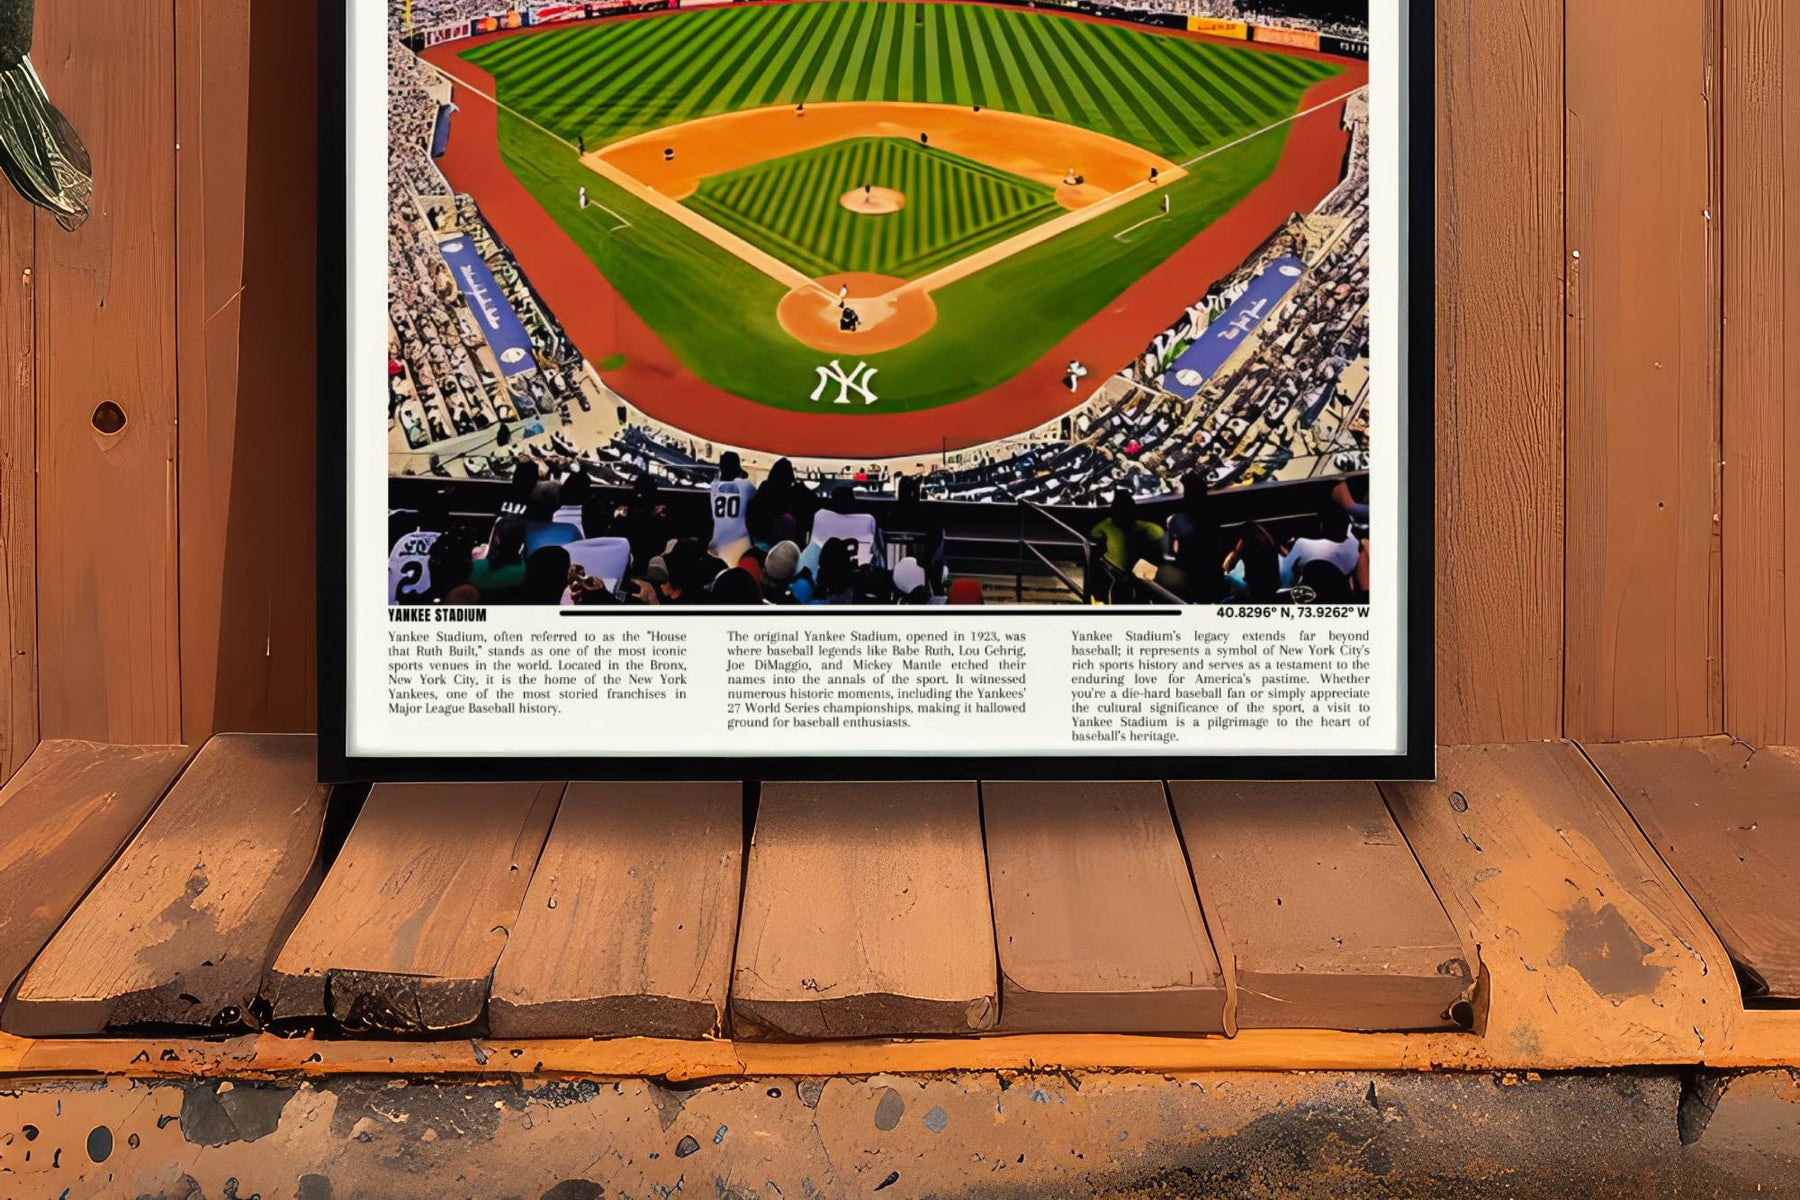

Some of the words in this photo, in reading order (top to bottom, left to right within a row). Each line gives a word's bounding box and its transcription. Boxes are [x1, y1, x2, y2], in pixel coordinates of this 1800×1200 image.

[810, 359, 878, 405] NY
[388, 608, 431, 622] YANKEE
[435, 608, 487, 622] STADIUM
[1281, 607, 1295, 621] N,
[1357, 607, 1370, 618] W
[389, 631, 429, 643] Yankee
[437, 631, 487, 644] Stadium,
[494, 631, 523, 643] often
[531, 631, 577, 643] referred
[585, 631, 595, 643] to
[602, 634, 615, 643] as
[622, 631, 640, 643] the
[727, 630, 749, 642] The
[754, 630, 798, 645] original
[804, 630, 845, 642] Yankee
[850, 630, 901, 644] Stadium,
[906, 630, 948, 645] opened
[954, 630, 965, 642] in
[971, 630, 1000, 644] 1923,
[1005, 633, 1026, 642] was
[1072, 630, 1113, 642] Yankee
[1195, 630, 1229, 645] legacy
[1242, 630, 1286, 642] extends
[1300, 630, 1316, 642] far
[1329, 630, 1369, 645] beyond
[388, 645, 410, 657] that
[416, 645, 443, 657] Ruth
[488, 645, 525, 657] stands
[530, 648, 544, 657] as
[549, 648, 571, 657] one
[576, 645, 589, 657] of
[594, 645, 612, 657] the
[618, 645, 646, 657] most
[652, 645, 687, 657] iconic
[727, 645, 762, 657] where
[767, 645, 813, 657] baseball
[819, 645, 862, 660] legends
[867, 645, 887, 657] like
[893, 645, 919, 657] Babe
[925, 645, 954, 658] Ruth,
[959, 645, 979, 657] Lou
[985, 645, 1026, 660] Gehrig,
[1072, 644, 1121, 659] baseball;
[1127, 644, 1134, 656] it
[1140, 644, 1200, 659] represents
[1205, 647, 1211, 656] a
[1217, 644, 1257, 659] symbol
[1263, 644, 1275, 656] of
[1280, 644, 1303, 656] New
[1309, 644, 1335, 656] York
[388, 659, 423, 674] sports
[429, 662, 469, 671] venues
[475, 659, 486, 671] in
[493, 659, 511, 671] the
[517, 659, 552, 671] world.
[559, 659, 601, 671] Located
[609, 659, 619, 671] in
[626, 659, 644, 671] the
[651, 659, 686, 673] Bronx,
[726, 659, 745, 674] Joe
[755, 659, 811, 674] DiMaggio,
[821, 659, 842, 671] and
[853, 659, 892, 674] Mickey
[903, 659, 941, 671] Mantle
[951, 659, 988, 671] etched
[999, 659, 1026, 671] their
[1072, 658, 1094, 670] rich
[1099, 658, 1134, 673] sports
[1139, 658, 1178, 673] history
[1182, 658, 1204, 670] and
[1208, 661, 1243, 670] serves
[1248, 661, 1260, 670] as
[1265, 661, 1272, 670] a
[1276, 658, 1332, 670] testament
[1337, 658, 1348, 670] to
[1352, 658, 1370, 670] the
[728, 676, 765, 685] names
[773, 673, 795, 685] into
[802, 673, 820, 685] the
[828, 673, 866, 685] annals
[873, 673, 885, 685] of
[892, 673, 909, 685] the
[916, 673, 949, 688] sport.
[956, 673, 963, 685] It
[970, 673, 1026, 685] witnessed
[1071, 673, 1125, 688] enduring
[1135, 673, 1157, 685] love
[1168, 673, 1185, 685] for
[1262, 673, 1309, 688] pastime.
[1320, 673, 1370, 685] Whether
[388, 688, 438, 702] Yankees,
[446, 691, 467, 700] one
[476, 688, 488, 700] of
[496, 688, 514, 700] the
[523, 688, 551, 700] most
[559, 688, 598, 700] storied
[607, 688, 666, 700] franchises
[675, 688, 686, 700] in
[728, 691, 786, 700] numerous
[790, 688, 834, 700] historic
[838, 688, 894, 701] moments,
[898, 688, 952, 703] including
[956, 688, 973, 700] the
[1111, 690, 1117, 699] a
[1122, 687, 1170, 699] die-hard
[1176, 687, 1221, 699] baseball
[1228, 687, 1245, 699] fan
[1250, 690, 1263, 699] or
[1268, 687, 1305, 702] simply
[1310, 687, 1369, 702] appreciate
[389, 702, 422, 717] Major
[426, 702, 465, 717] League
[469, 702, 515, 714] Baseball
[519, 702, 561, 717] history.
[728, 702, 741, 714] 27
[745, 702, 780, 714] World
[785, 702, 819, 714] Series
[823, 702, 913, 717] championships,
[918, 702, 960, 717] making
[964, 702, 971, 714] it
[976, 702, 1026, 714] hallowed
[1072, 701, 1089, 713] the
[1097, 701, 1142, 713] cultural
[1150, 701, 1219, 716] significance
[1227, 701, 1239, 713] of
[1247, 701, 1264, 713] the
[1272, 701, 1304, 716] sport,
[1312, 704, 1319, 713] a
[1327, 701, 1350, 713] visit
[1359, 701, 1370, 713] to
[1130, 730, 1179, 745] heritage.
